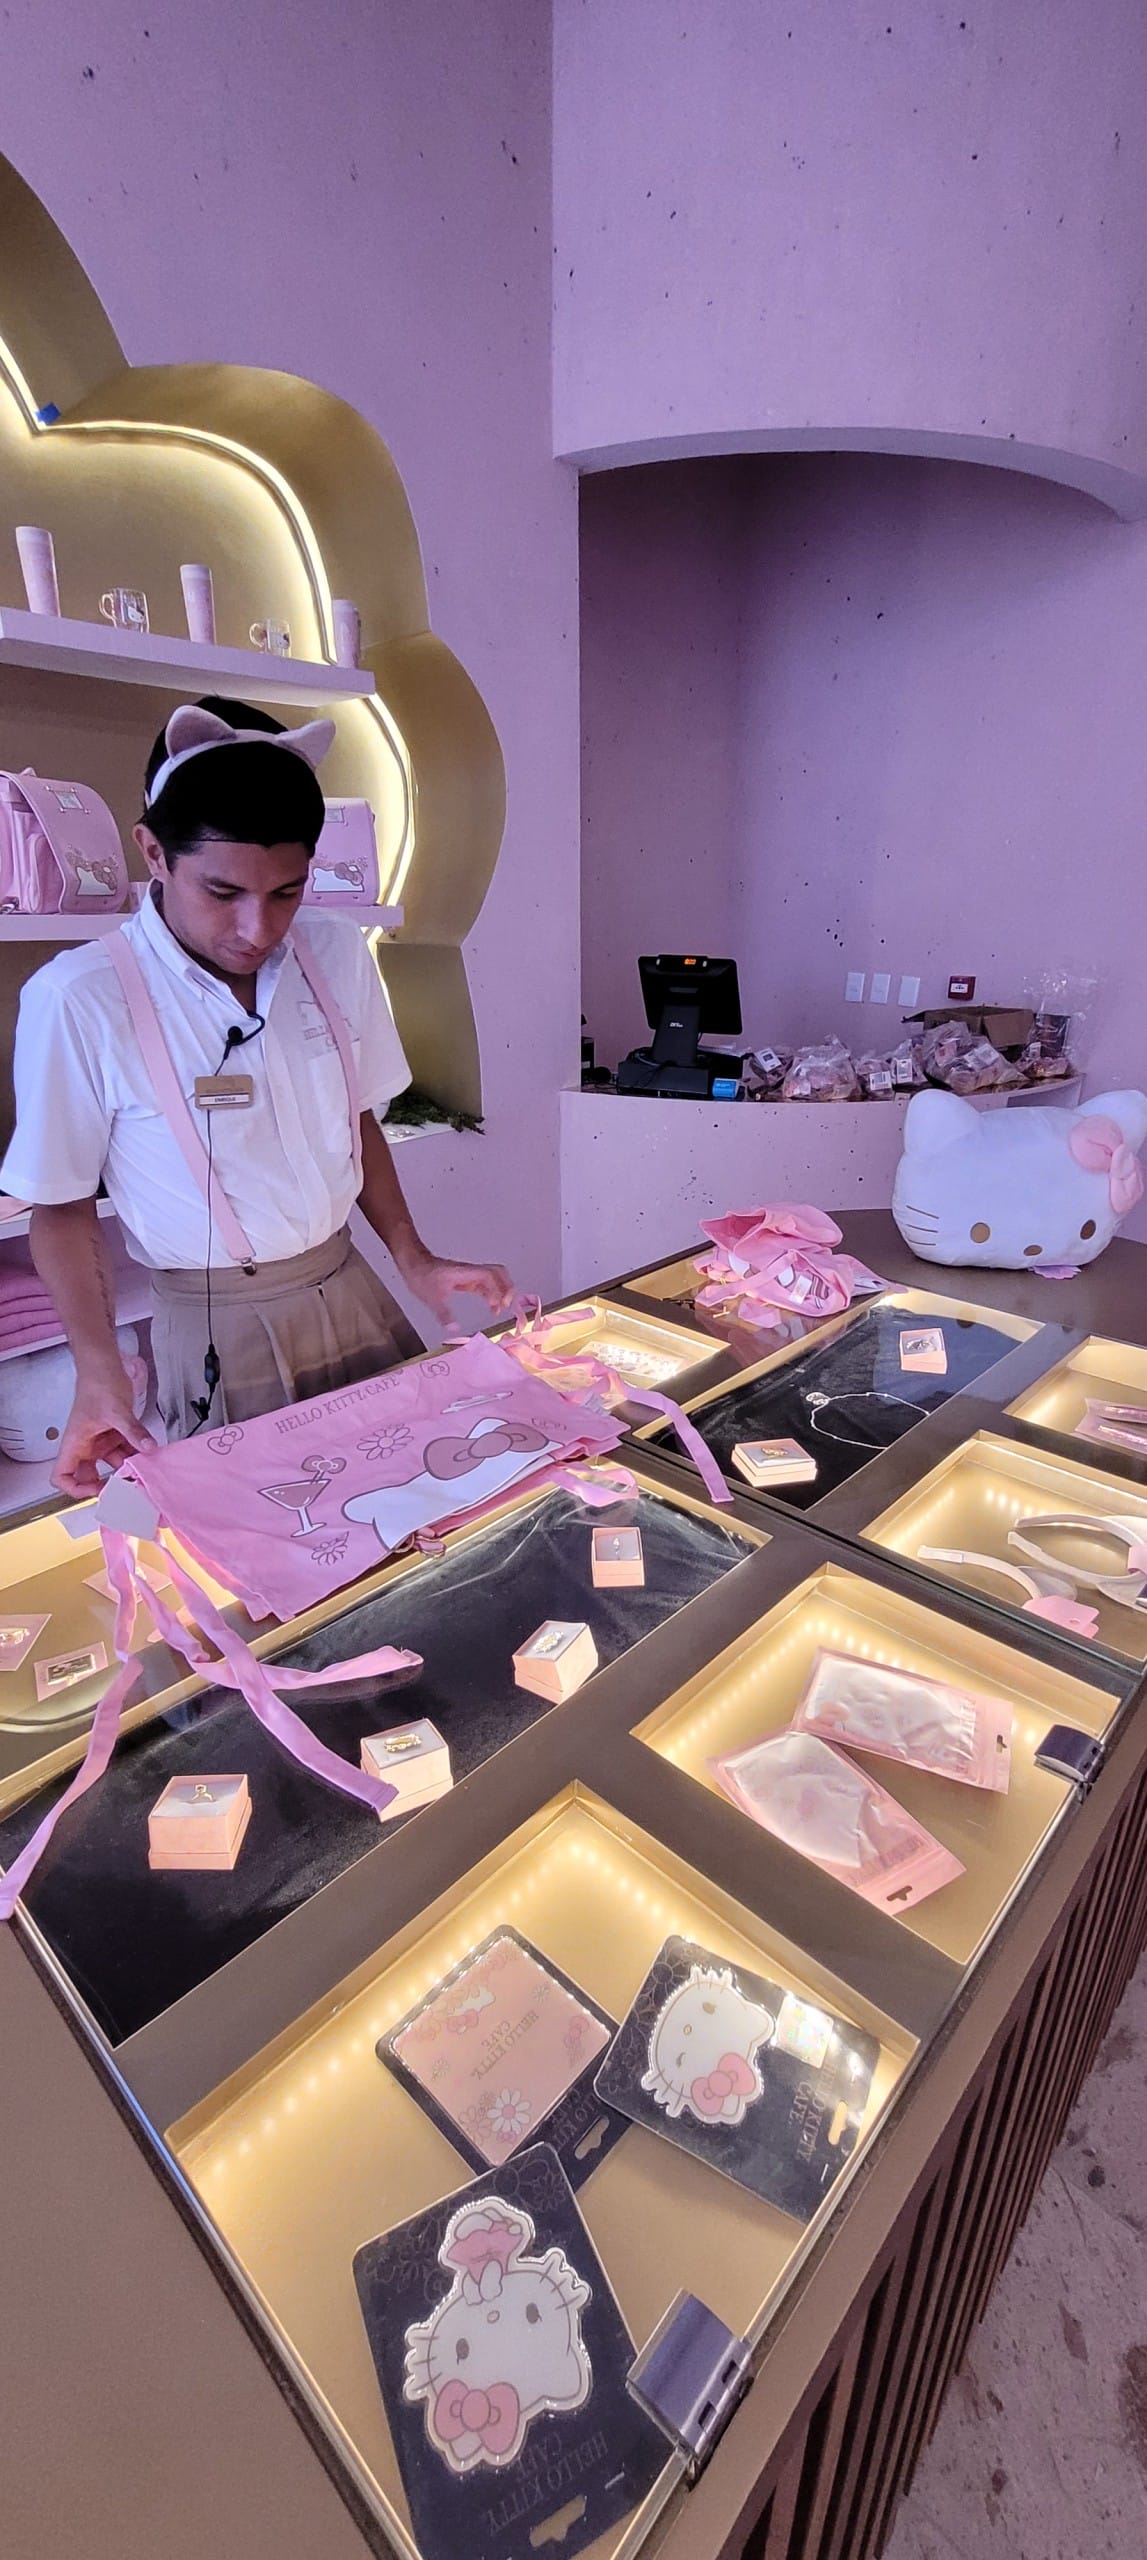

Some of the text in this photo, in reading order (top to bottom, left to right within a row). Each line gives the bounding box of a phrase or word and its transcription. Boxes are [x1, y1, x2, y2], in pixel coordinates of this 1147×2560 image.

[275, 1406, 323, 1434] HELLO
[323, 1388, 364, 1414] KITTY
[472, 2009, 540, 2081] HELLO KITTY
[481, 2019, 511, 2051] CAFE
[486, 2431, 609, 2536] HELLO KITTY
